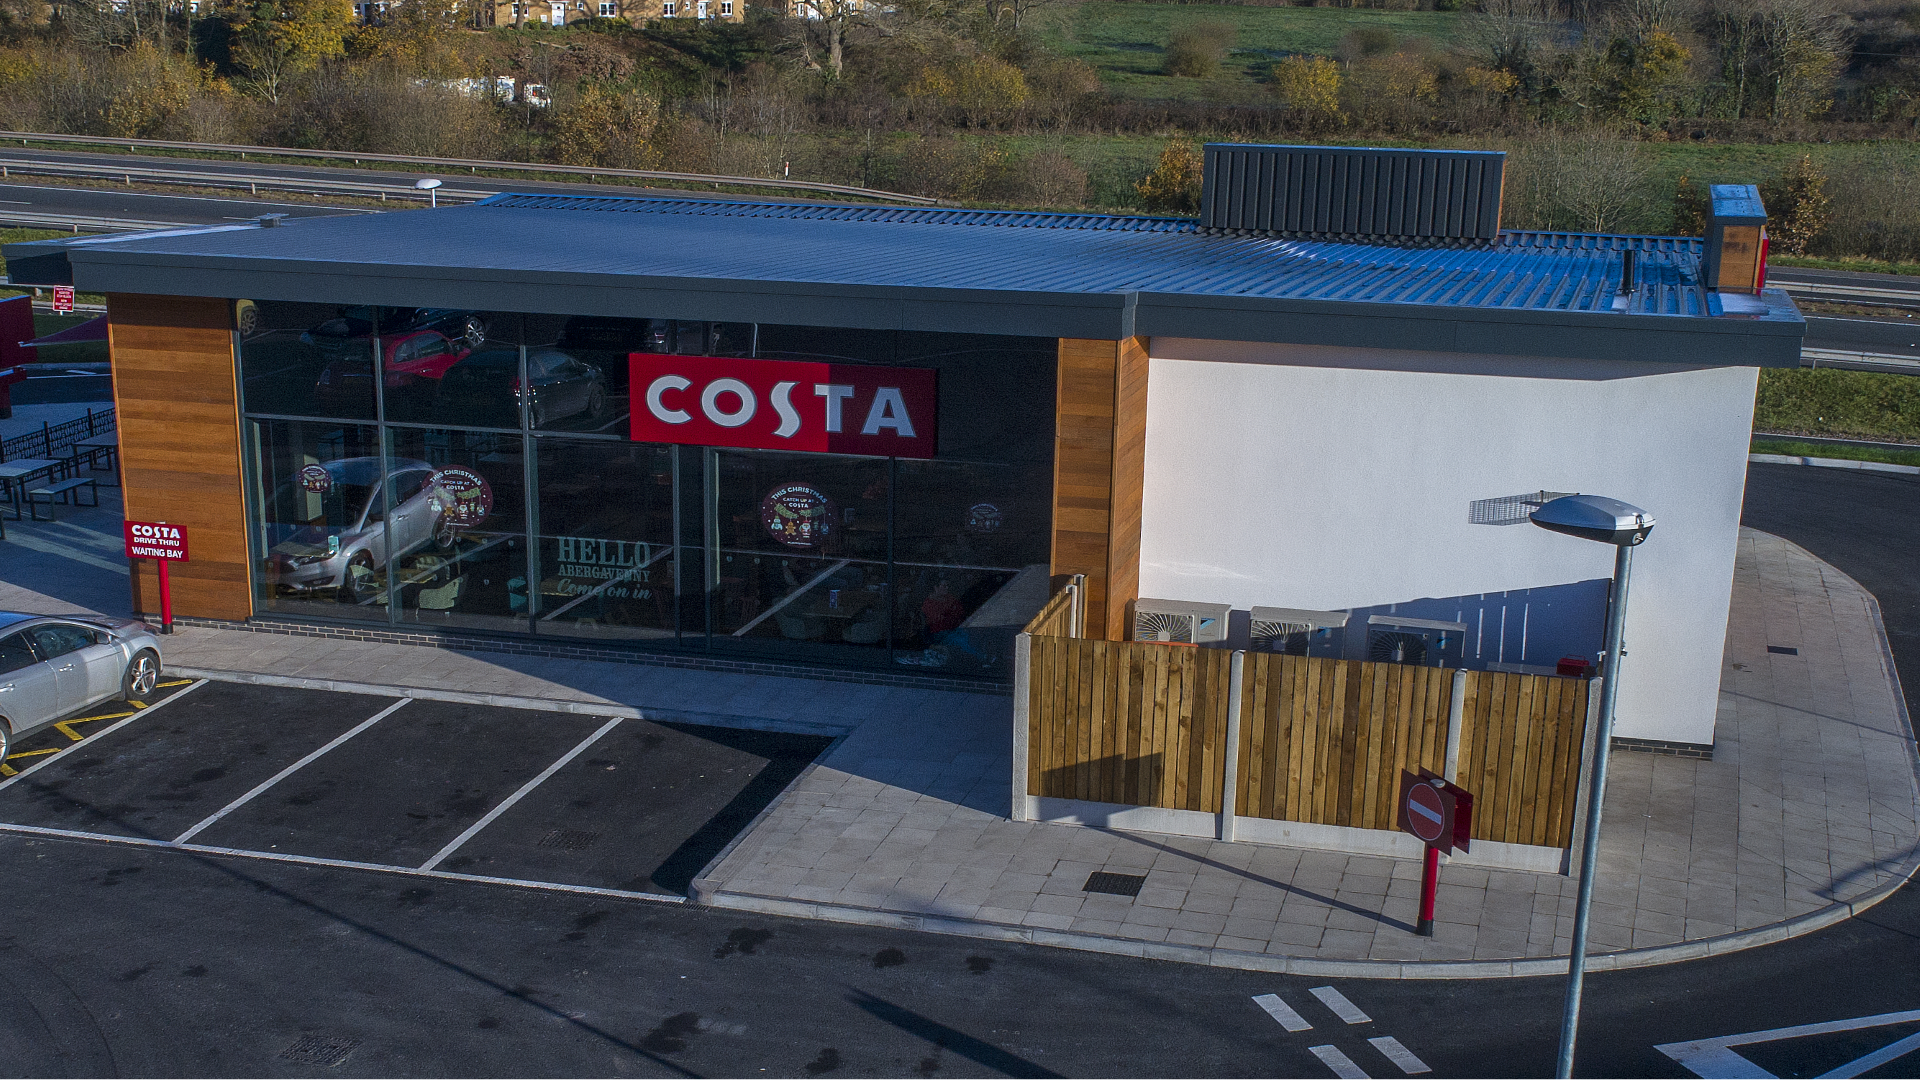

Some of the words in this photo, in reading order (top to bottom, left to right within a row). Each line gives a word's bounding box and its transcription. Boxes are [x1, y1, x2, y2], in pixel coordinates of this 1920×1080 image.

[645, 373, 917, 439] COSTA
[430, 472, 444, 482] THIS
[444, 469, 482, 486] CHRISTMAS
[771, 489, 787, 500] THIS
[787, 486, 828, 503] CHRISTMAS
[131, 524, 181, 539] COSTA
[133, 537, 157, 545] DRIVE
[158, 538, 180, 547] THRU
[131, 546, 166, 557] WAITING
[166, 549, 184, 559] BAY
[557, 536, 651, 567] HELLO
[557, 564, 651, 583] ABERGAVENNY
[557, 578, 603, 596] Come
[607, 586, 631, 598] on
[632, 583, 653, 600] in
